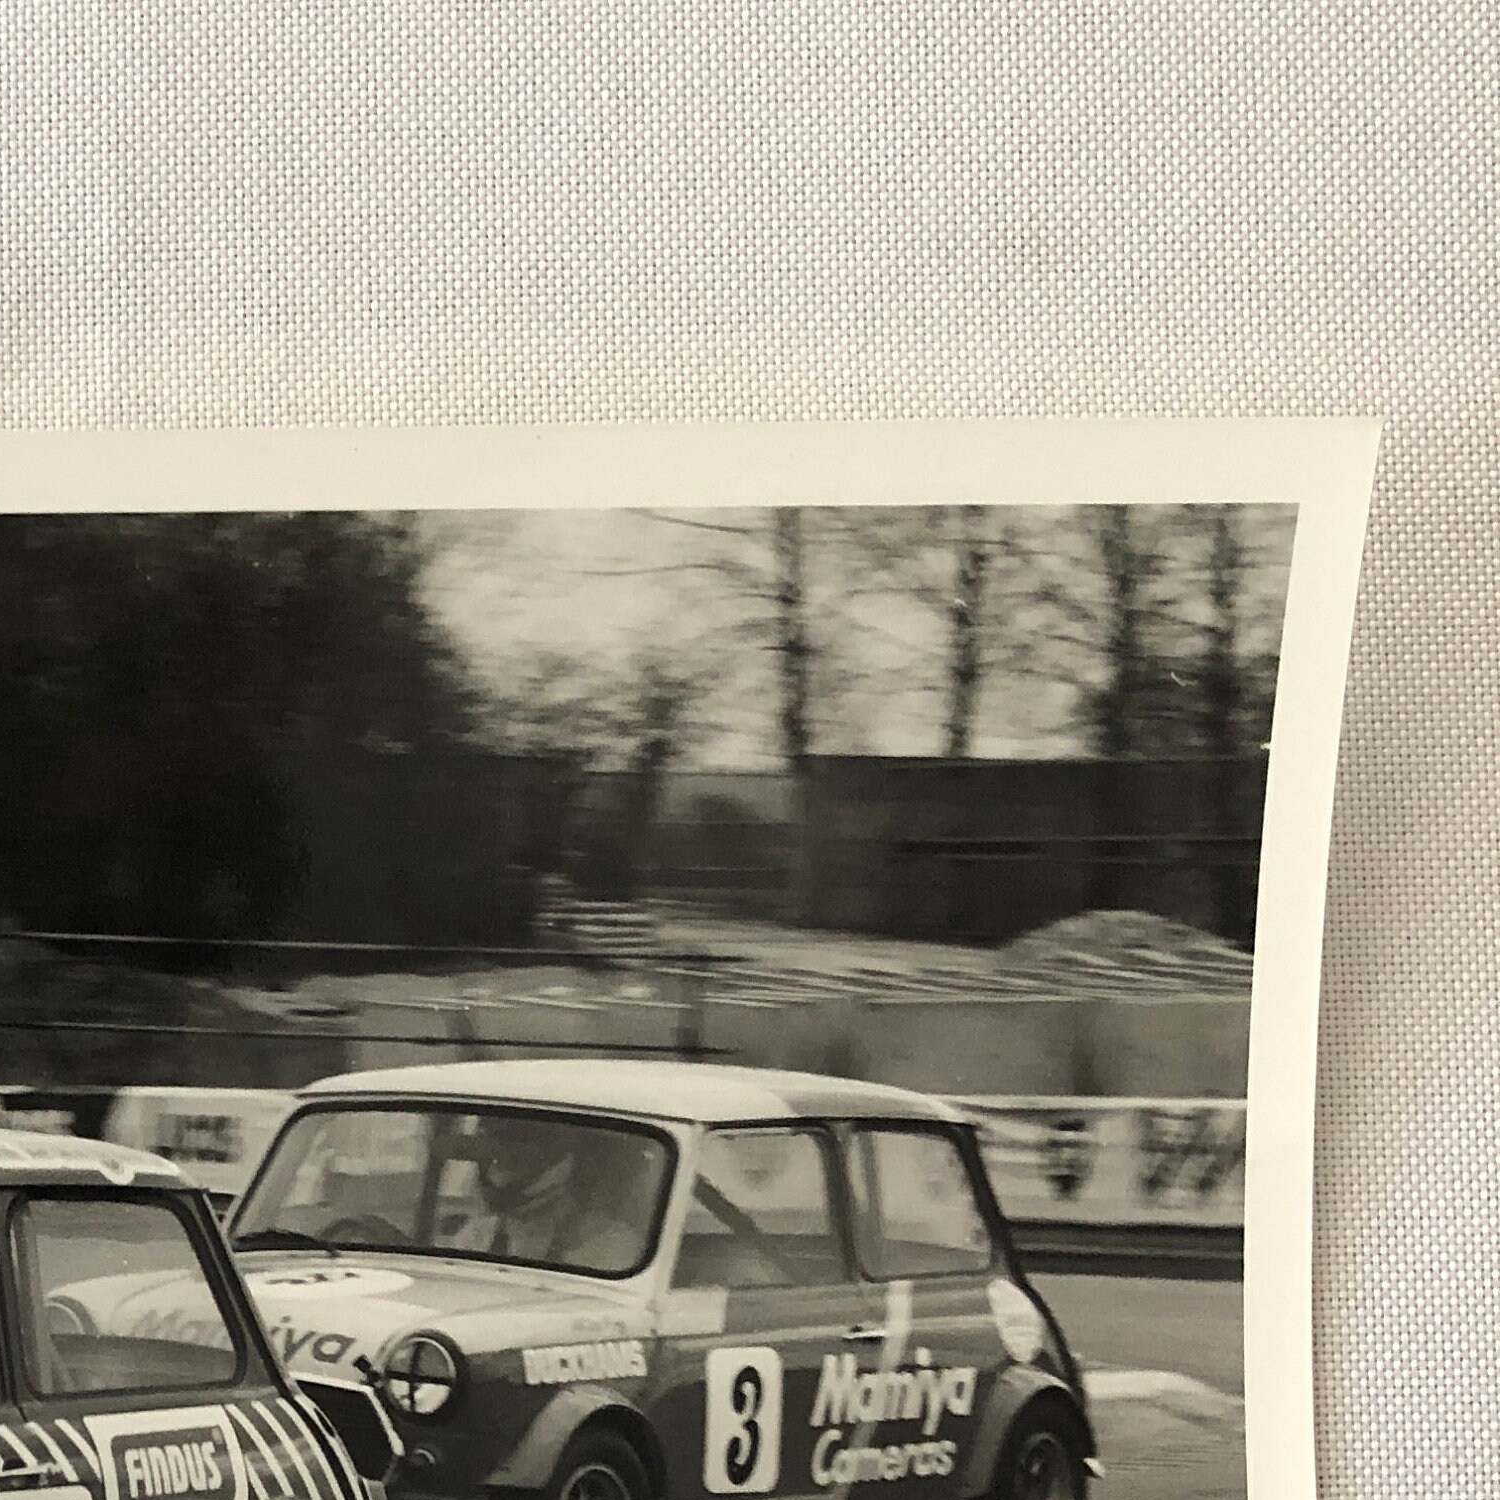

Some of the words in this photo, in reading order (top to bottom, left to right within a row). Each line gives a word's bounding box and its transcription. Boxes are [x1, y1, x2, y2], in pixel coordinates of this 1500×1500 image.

[725, 1365, 762, 1487] 3
[808, 1346, 978, 1437] Mamiya
[123, 1440, 223, 1500] FINDUS
[811, 1428, 957, 1487] Cameras
